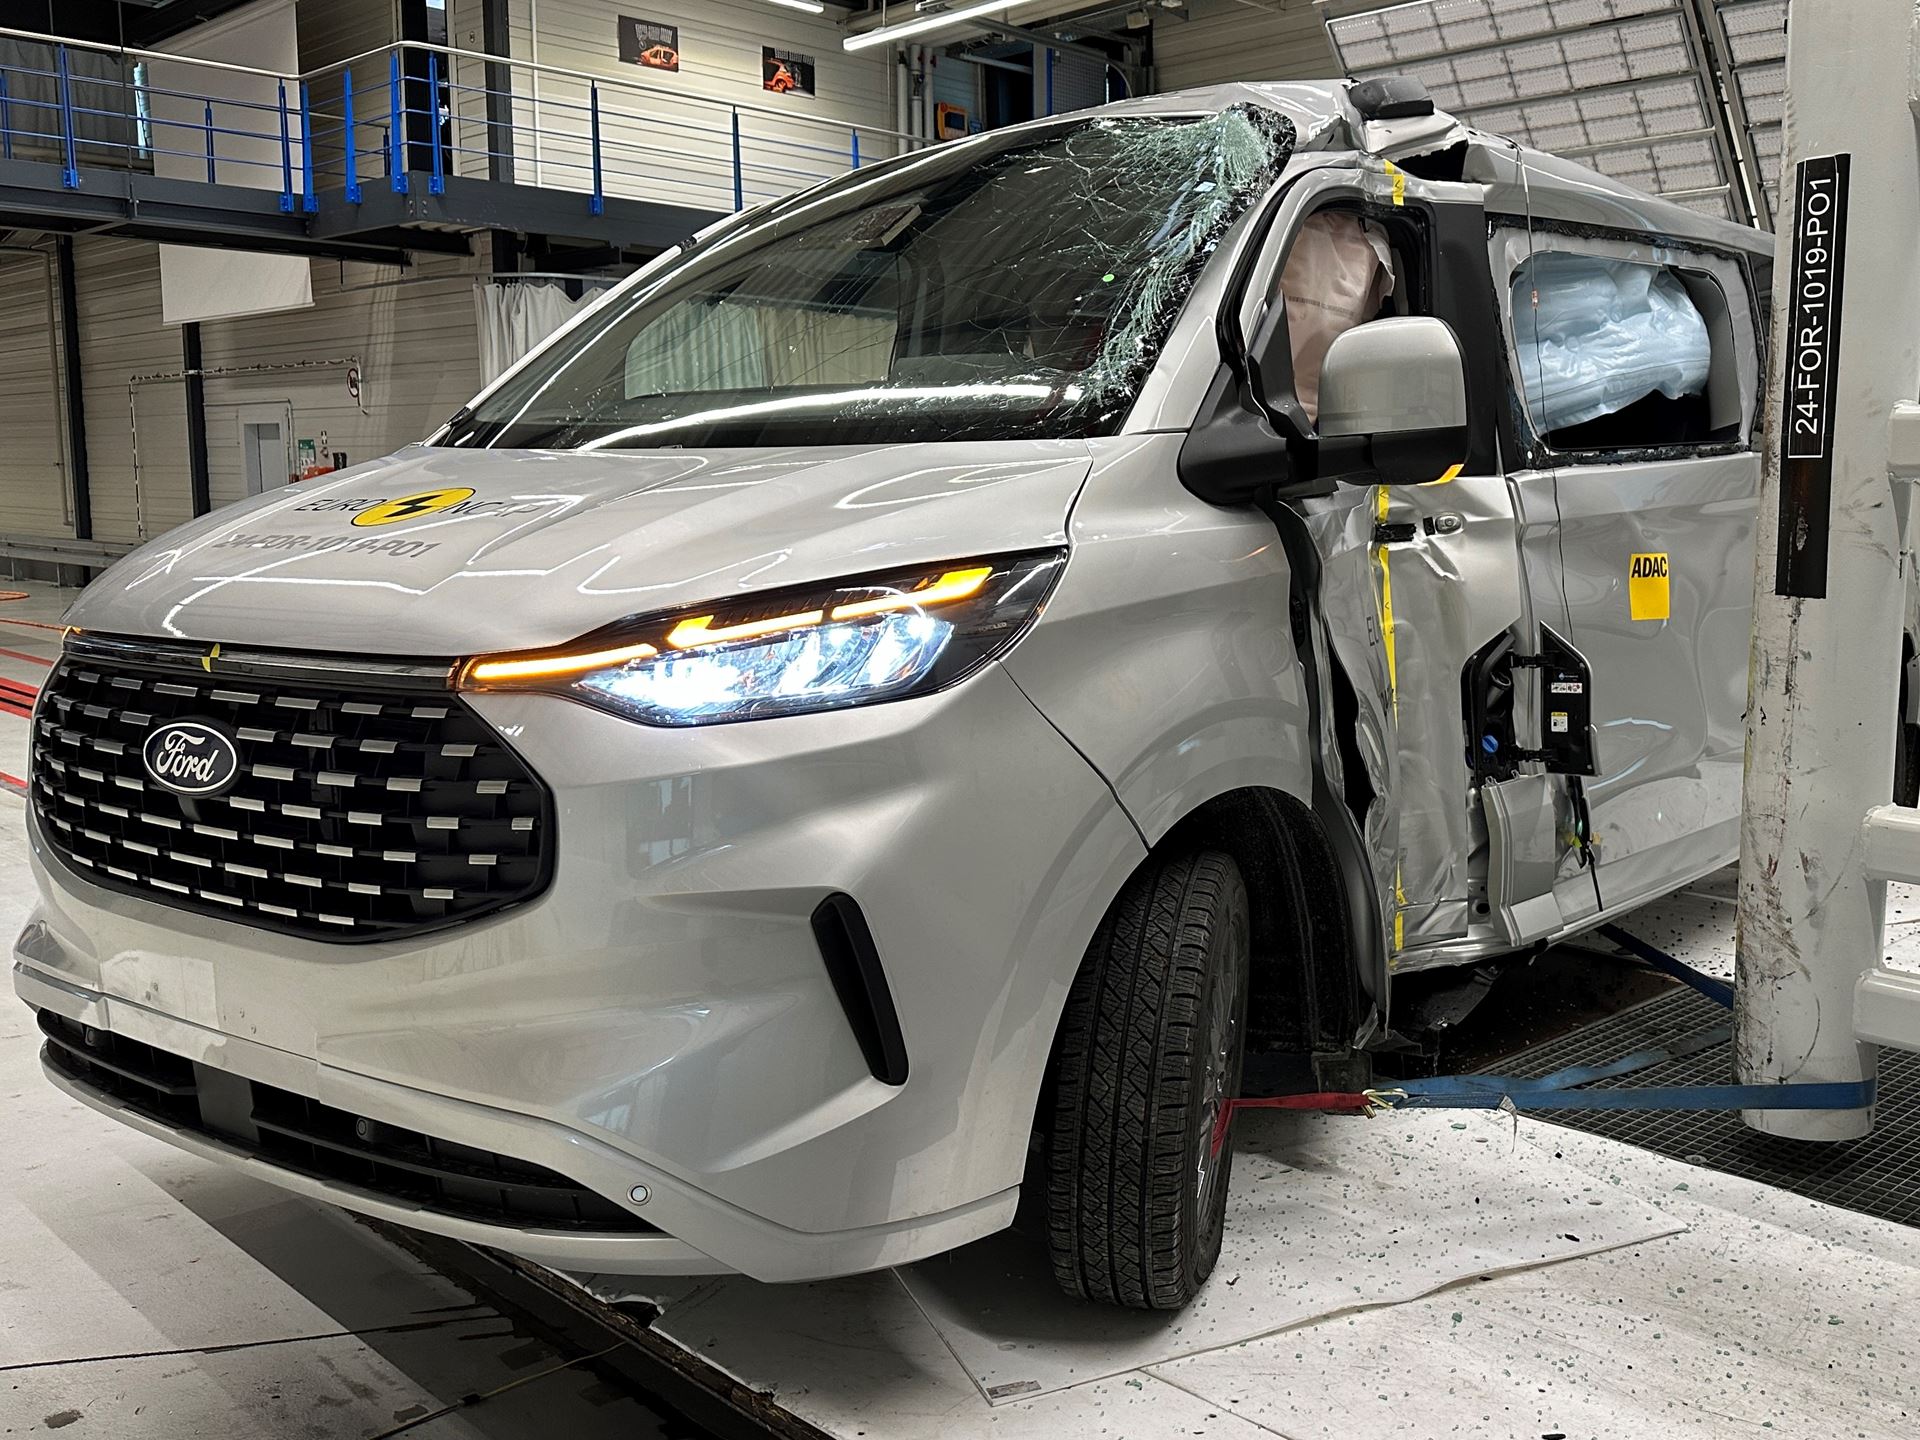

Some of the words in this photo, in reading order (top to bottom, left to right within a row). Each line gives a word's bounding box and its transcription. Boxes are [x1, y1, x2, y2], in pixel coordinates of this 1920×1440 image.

[293, 498, 386, 511] EURO
[1631, 556, 1668, 578] ADAC
[156, 730, 219, 782] Ford
